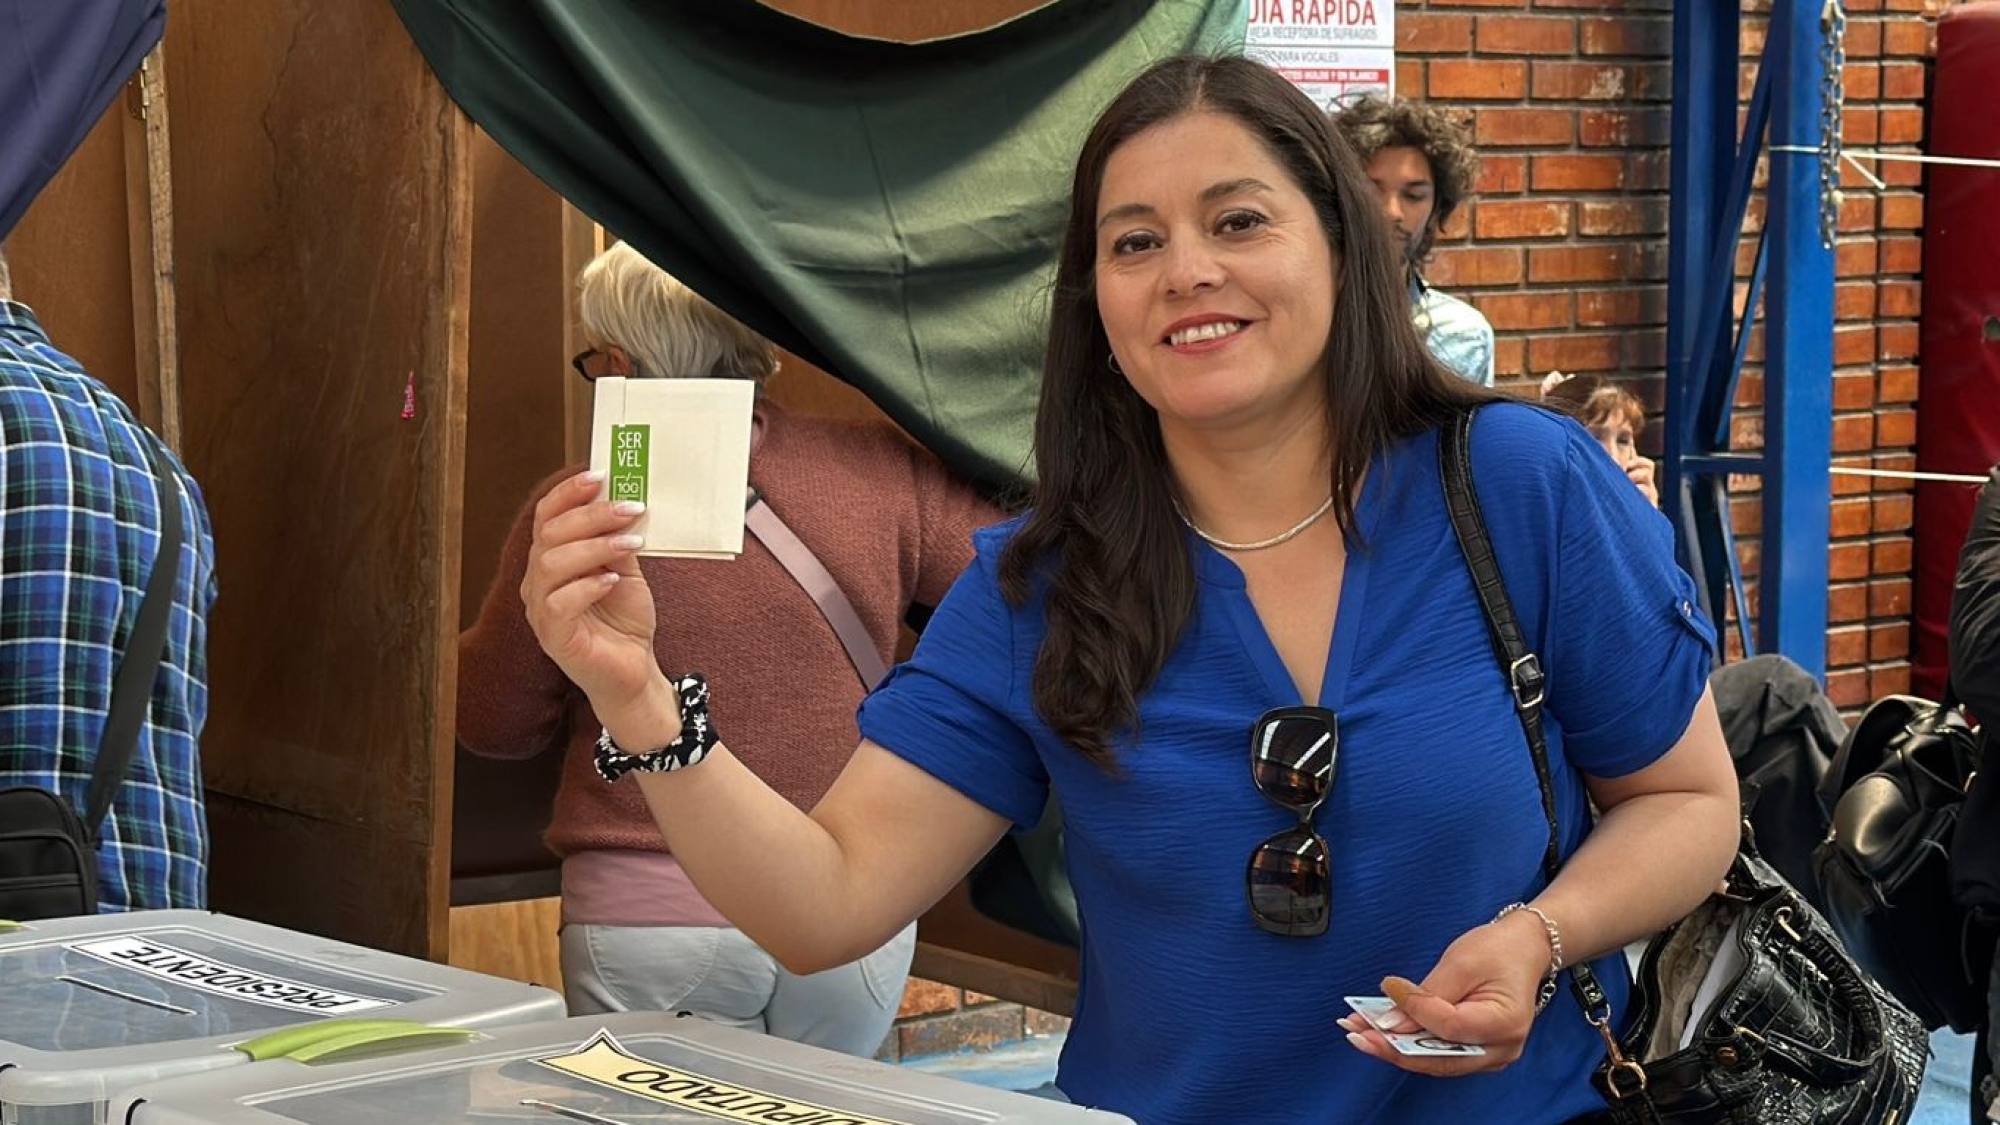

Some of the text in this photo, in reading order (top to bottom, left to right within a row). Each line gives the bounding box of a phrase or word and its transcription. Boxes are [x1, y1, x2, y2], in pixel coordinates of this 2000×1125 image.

[1273, 26, 1320, 38] RECEPTORA
[1322, 28, 1331, 38] DE
[1334, 28, 1378, 40] SUFRAGIOS
[1302, 51, 1338, 62] VOCALES
[617, 431, 642, 449] SER
[617, 449, 642, 467] VEL
[111, 946, 357, 1010] PRESIDENTE
